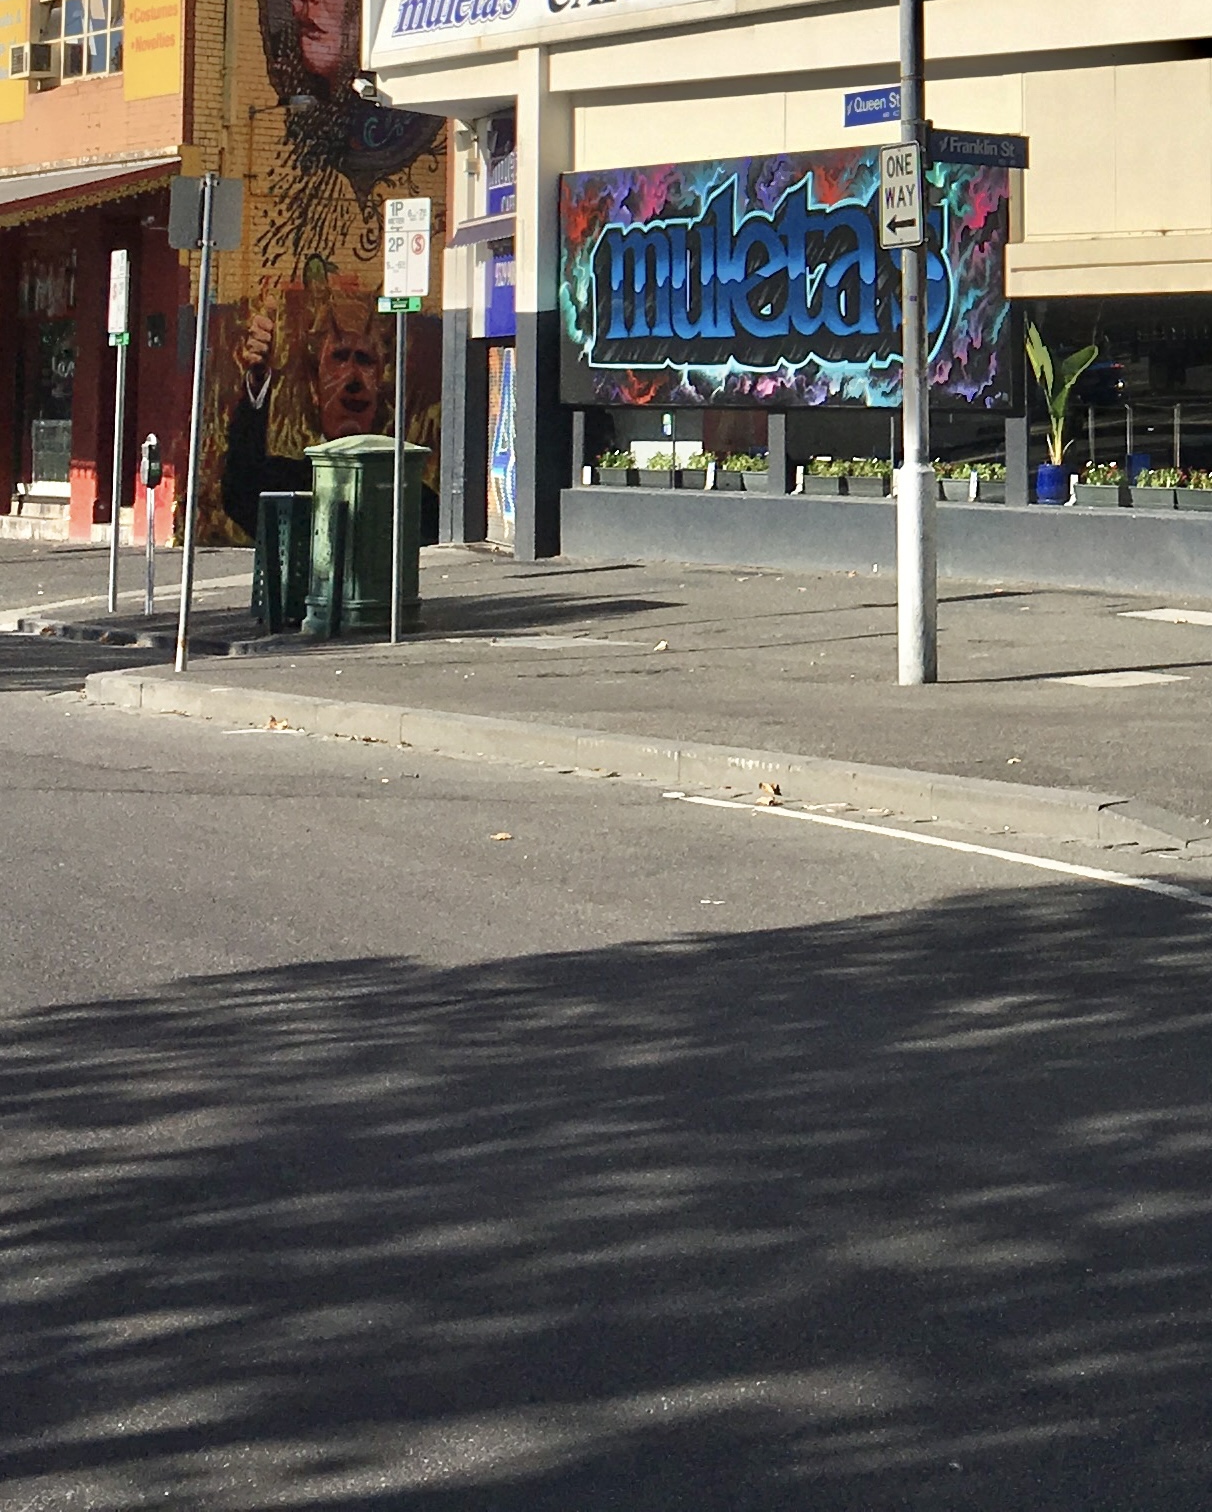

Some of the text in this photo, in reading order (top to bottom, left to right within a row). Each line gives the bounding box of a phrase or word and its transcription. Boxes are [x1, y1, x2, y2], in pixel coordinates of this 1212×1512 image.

[133, 4, 178, 24] Costumes
[135, 33, 176, 53] Novelties
[854, 92, 901, 112] Queen St
[950, 137, 1015, 157] Franklin St
[886, 153, 914, 178] ONE
[885, 184, 915, 209] WAY
[390, 201, 404, 216] 1P
[388, 237, 404, 253] 2P
